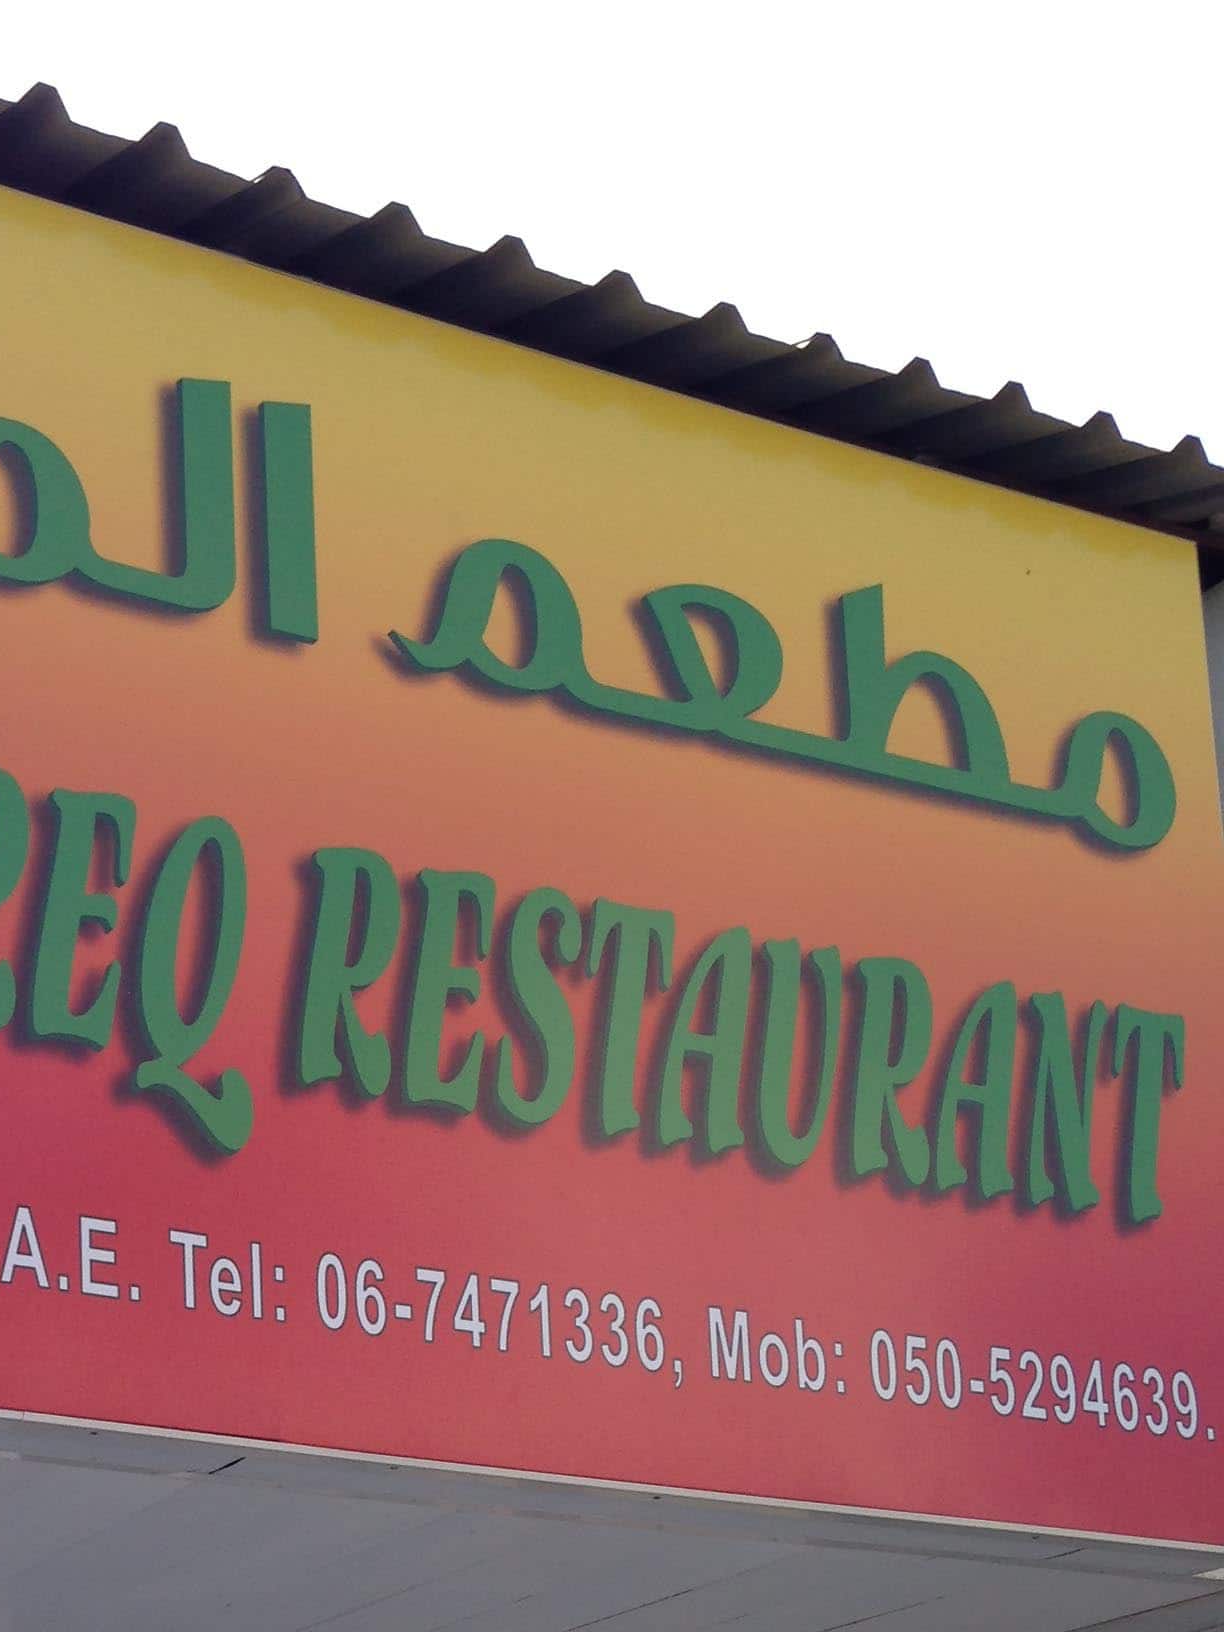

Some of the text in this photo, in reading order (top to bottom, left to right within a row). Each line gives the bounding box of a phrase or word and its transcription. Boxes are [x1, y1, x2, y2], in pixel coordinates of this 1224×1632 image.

[390, 539, 1176, 849] مطعم
[298, 848, 1186, 1224] RESTAURANT
[169, 1229, 287, 1322] Tel:
[316, 1252, 684, 1389] 06-7471336,
[707, 1306, 848, 1394] Mob:
[869, 1329, 1217, 1442] 050-5294639.
